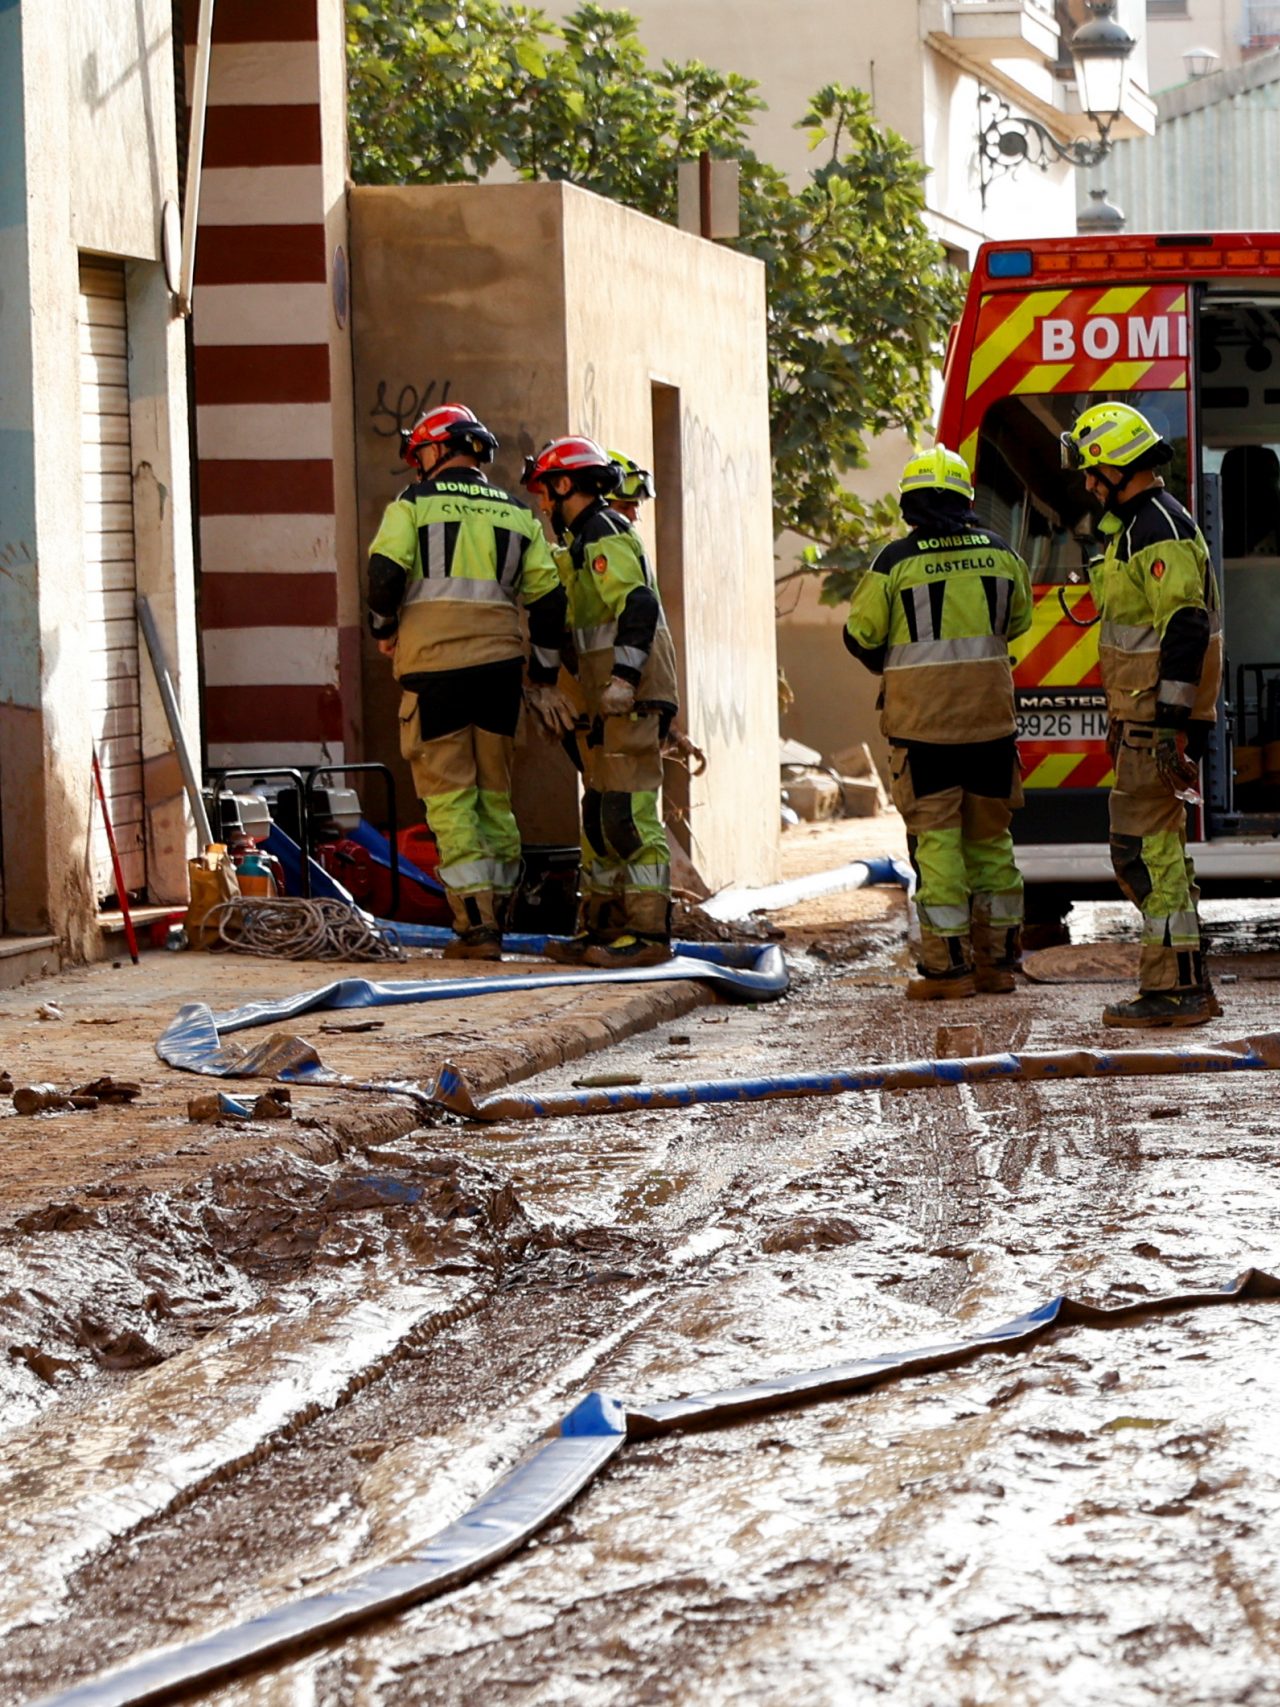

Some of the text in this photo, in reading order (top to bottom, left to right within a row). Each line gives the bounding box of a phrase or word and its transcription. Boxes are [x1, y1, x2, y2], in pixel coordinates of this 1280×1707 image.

[917, 534, 991, 550] BOMBERS
[925, 556, 995, 575] CASTELLÓ
[1020, 696, 1106, 708] MASTER
